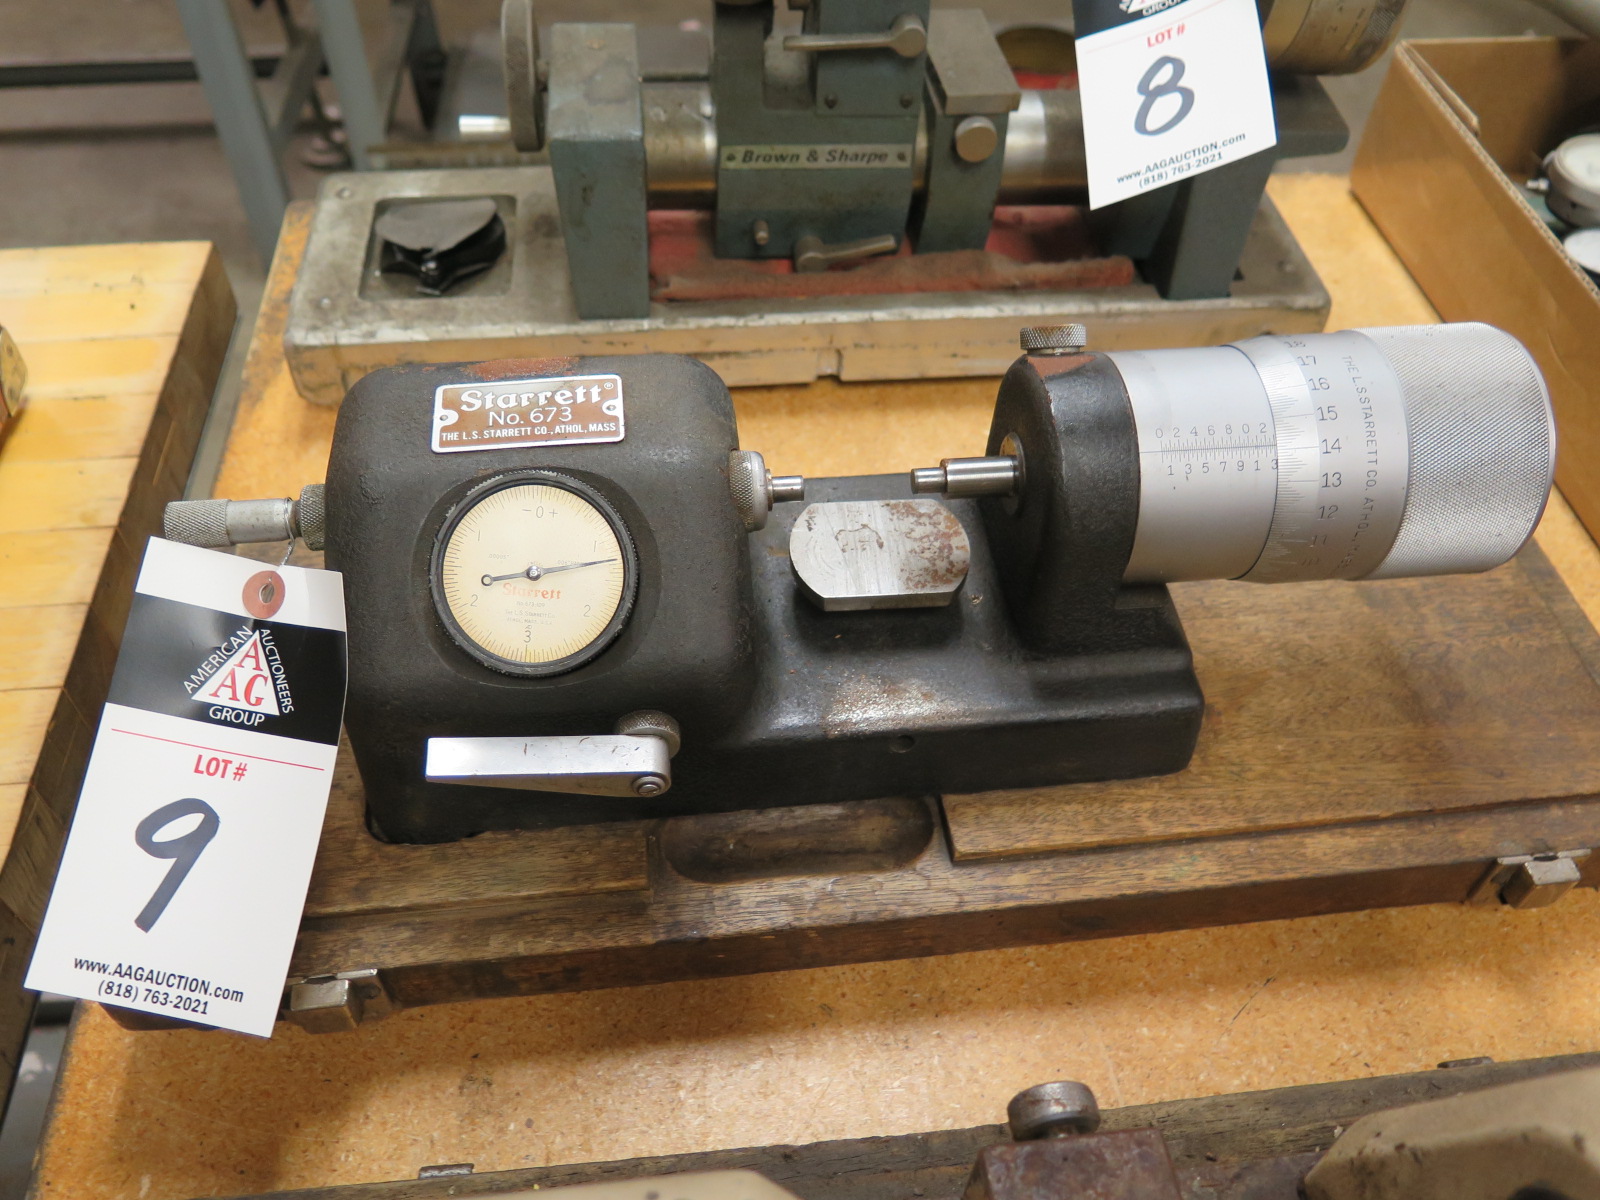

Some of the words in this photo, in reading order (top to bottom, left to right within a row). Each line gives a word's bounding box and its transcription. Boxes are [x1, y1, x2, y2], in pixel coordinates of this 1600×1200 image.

[1147, 27, 1173, 48] LOT
[1134, 55, 1195, 136] 8
[741, 149, 800, 164] Brown
[806, 150, 819, 163] &
[825, 149, 889, 165] Sharpe
[1117, 132, 1246, 184] www.AAGAUCTION.com
[1139, 170, 1168, 189] (818)
[1172, 151, 1223, 177] 763-2021
[1297, 355, 1317, 366] 17
[1308, 377, 1330, 391] 16
[488, 410, 525, 427] No.
[529, 406, 573, 424] 673
[1317, 405, 1338, 421] 15
[1341, 355, 1359, 373] THE
[1365, 470, 1378, 491] CO.
[441, 431, 460, 442] THE
[462, 430, 482, 440] L.S.
[483, 427, 531, 439] STARRETT
[589, 422, 616, 433] MASS
[1155, 428, 1163, 438] 0
[1173, 427, 1180, 438] 2
[1190, 426, 1198, 437] 4
[1207, 425, 1215, 436] 6
[1225, 424, 1233, 434] 8
[1242, 423, 1250, 434] 0
[1259, 423, 1267, 433] 2
[1321, 438, 1342, 454] 14
[1168, 465, 1174, 475] 1
[1185, 463, 1192, 474] 3
[1202, 462, 1210, 473] 5
[1220, 461, 1227, 472] 7
[1237, 460, 1244, 471] 9
[1254, 460, 1261, 471] 1
[1271, 459, 1278, 470] 3
[1321, 471, 1342, 488] 13
[1318, 505, 1339, 520] 12
[470, 594, 478, 607] 2
[502, 582, 561, 600] Starrett
[583, 604, 591, 618] 2
[523, 630, 532, 643] 3
[183, 625, 253, 694] AMERICAN
[260, 628, 294, 714] AUCTIONEERS
[209, 705, 265, 727] GROUP
[193, 754, 233, 779] LOT
[135, 797, 221, 934] 9
[73, 957, 244, 1003] www.AAGAUCTION.com
[98, 979, 139, 1003] (818)
[143, 987, 209, 1016] 763-2021
